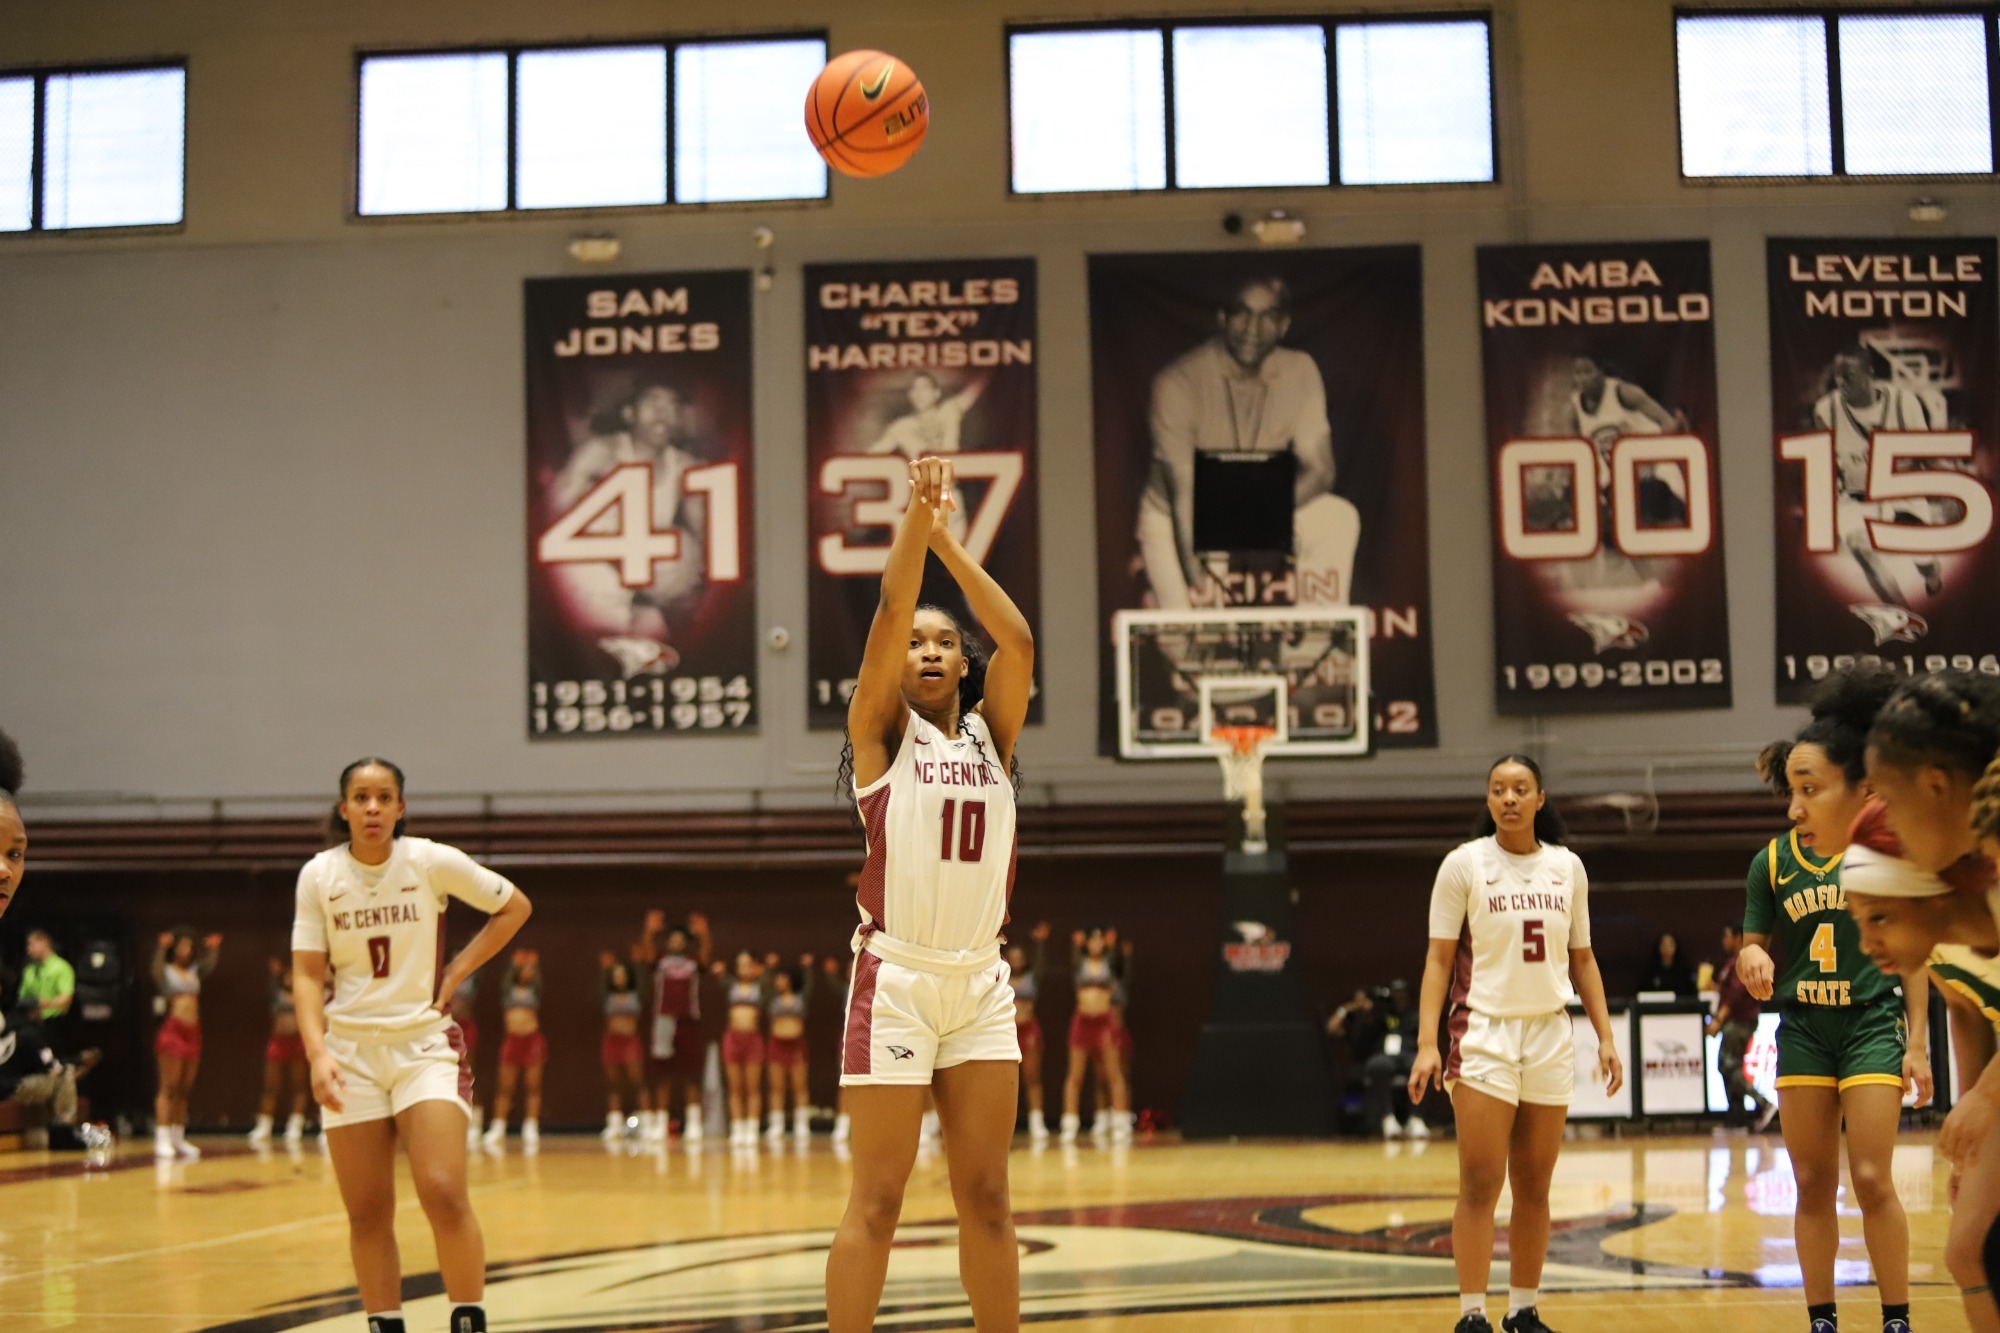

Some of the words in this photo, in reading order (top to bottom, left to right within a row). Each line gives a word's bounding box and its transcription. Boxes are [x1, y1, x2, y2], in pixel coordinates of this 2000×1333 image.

[1529, 260, 1662, 291] AMBA
[1787, 254, 1983, 283] LEVELLE
[586, 288, 688, 319] SAM
[819, 278, 1020, 310] CHARLES
[1804, 290, 1968, 319] MOTON
[1484, 294, 1711, 328] KONGOLO
[554, 323, 720, 357] JONES
[808, 339, 1032, 371] HARRISON
[1499, 433, 1712, 560] 00
[1779, 429, 1995, 555] 15
[538, 461, 742, 588] 41
[817, 451, 1025, 577] 37
[534, 675, 751, 704] 1951-1954
[1504, 659, 1724, 690] 1999-2002
[534, 703, 751, 731] 1956-1957
[915, 759, 934, 784] NC
[939, 798, 987, 863] 10
[333, 912, 351, 931] NC
[354, 903, 421, 930] CENTRAL
[1489, 896, 1507, 913] NC
[1511, 893, 1567, 913] CENTRAL
[1783, 884, 1848, 923] NORFOL
[367, 936, 390, 979] 0
[1522, 920, 1546, 963] 5
[1809, 923, 1837, 973] 4
[1797, 980, 1852, 1006] STATE
